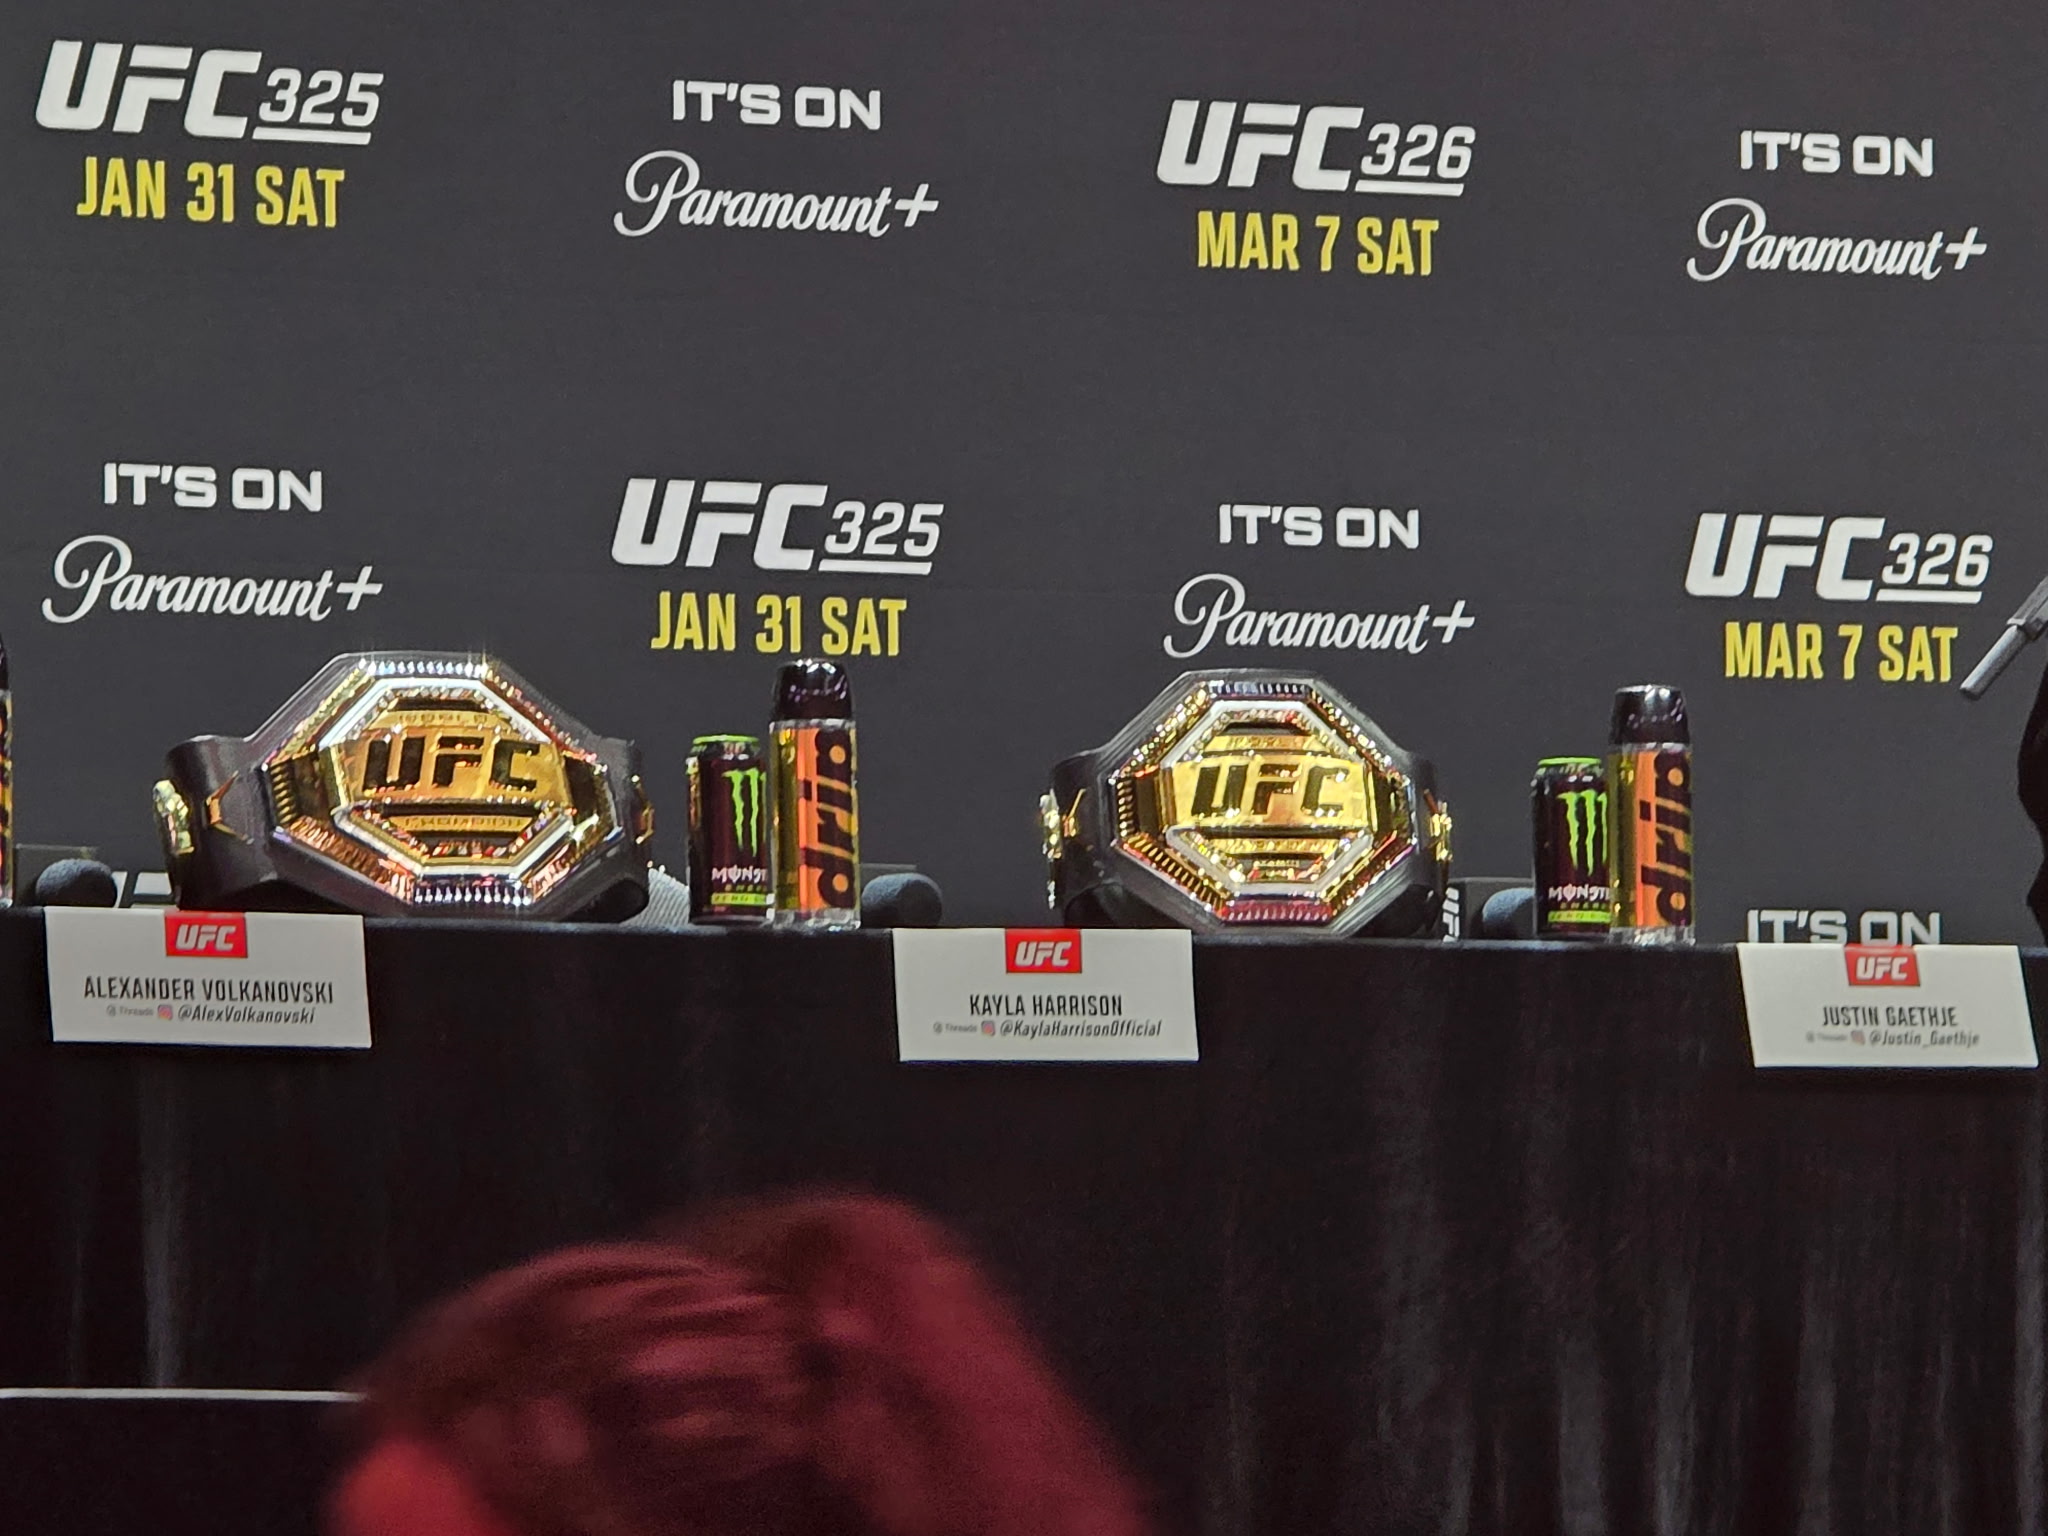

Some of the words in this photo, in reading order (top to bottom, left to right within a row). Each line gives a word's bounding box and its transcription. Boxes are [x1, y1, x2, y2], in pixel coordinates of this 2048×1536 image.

[36, 40, 262, 138] UFC
[260, 68, 383, 126] 325
[673, 80, 780, 124] IT'S
[795, 87, 880, 130] ON
[1157, 100, 1364, 191] UFC
[1361, 123, 1475, 178] 326
[1741, 131, 1840, 173] IT'S
[1853, 136, 1933, 177] ON
[77, 157, 165, 219] JAN
[187, 162, 234, 222] 31
[256, 166, 345, 227] SAT
[614, 151, 938, 237] Paramount+
[1198, 211, 1299, 270] MAR
[1315, 215, 1340, 271] 7
[1358, 217, 1439, 275] SAT
[1687, 198, 1987, 281] Paramount+
[105, 463, 217, 507] IT'S
[232, 468, 322, 511] ON
[612, 479, 828, 570] UFC
[825, 501, 944, 556] 325
[1220, 504, 1322, 546] IT'S
[1336, 508, 1419, 548] ON
[42, 535, 382, 623] Paramount+
[1685, 513, 1885, 600] UFC
[1882, 533, 1993, 586] 326
[651, 591, 735, 651] JAN
[756, 595, 801, 653] 31
[822, 597, 907, 656] SAT
[1164, 574, 1475, 658] Paramount+
[1726, 622, 1823, 679] MAR
[1838, 624, 1862, 680] 7
[1879, 625, 1958, 682] SAT
[362, 735, 540, 791] UFC
[1191, 763, 1349, 817] UFC
[175, 925, 236, 951] UFC
[1015, 941, 1072, 966] UFC
[1747, 910, 1848, 944] IT'S
[1860, 911, 1940, 946] ON
[84, 976, 195, 1001] ALEXANDER
[202, 979, 333, 1004] VOLKANOVSKI
[1856, 957, 1908, 980] UFC
[178, 1005, 315, 1024] @AlexVolkanovski
[970, 994, 1025, 1016] KAYLA
[1032, 994, 1122, 1016] HARRISON
[1000, 1019, 1162, 1039] @KaylaHarrisonOfficial
[1823, 1006, 1880, 1027] JUSTIN
[1886, 1006, 1959, 1027] GAETHJE
[1869, 1029, 1980, 1048] @Justin_Gaethje
